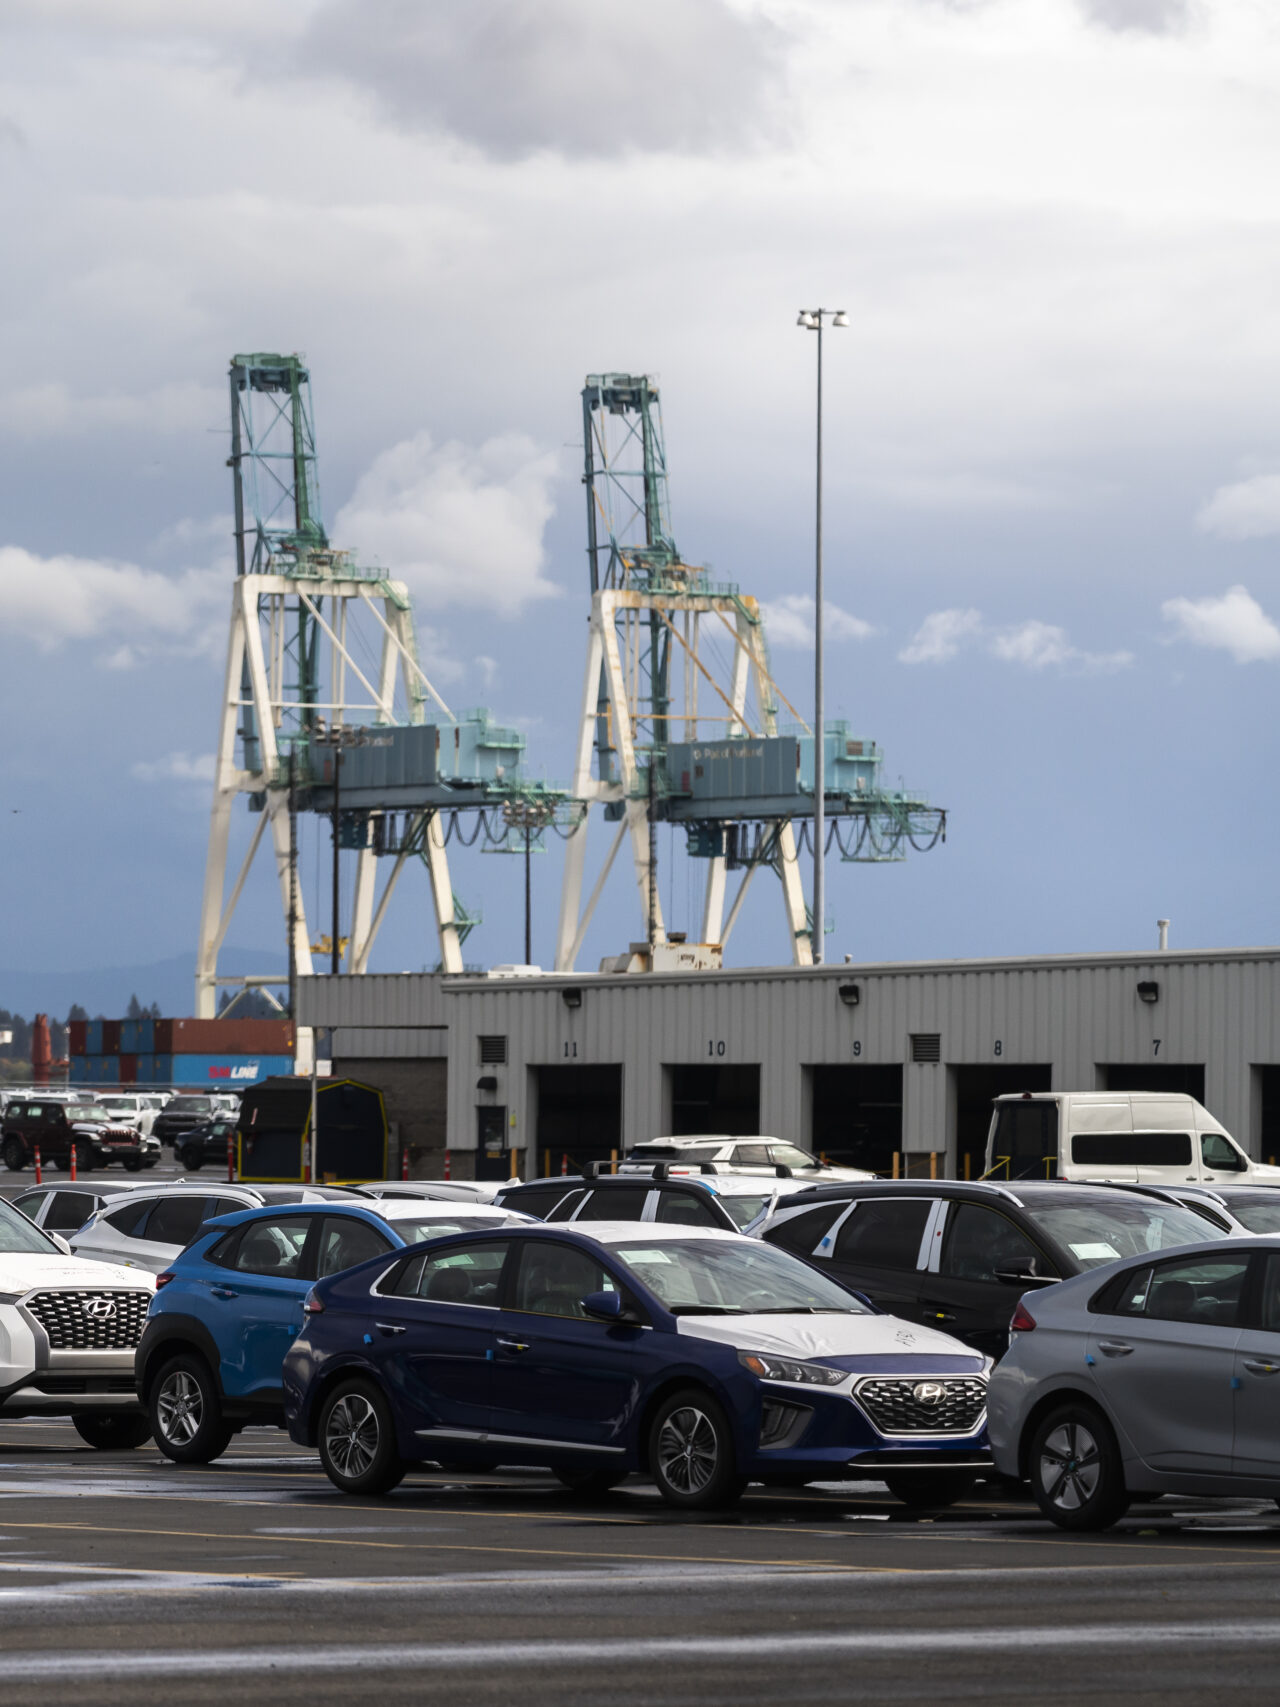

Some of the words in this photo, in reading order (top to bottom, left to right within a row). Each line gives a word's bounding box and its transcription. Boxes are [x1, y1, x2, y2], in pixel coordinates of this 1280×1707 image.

[563, 1041, 578, 1058] 11
[708, 1040, 726, 1057] 10
[853, 1040, 862, 1056] 9
[994, 1040, 1003, 1056] 8
[1152, 1039, 1162, 1057] 7
[230, 1066, 259, 1079] LINE
